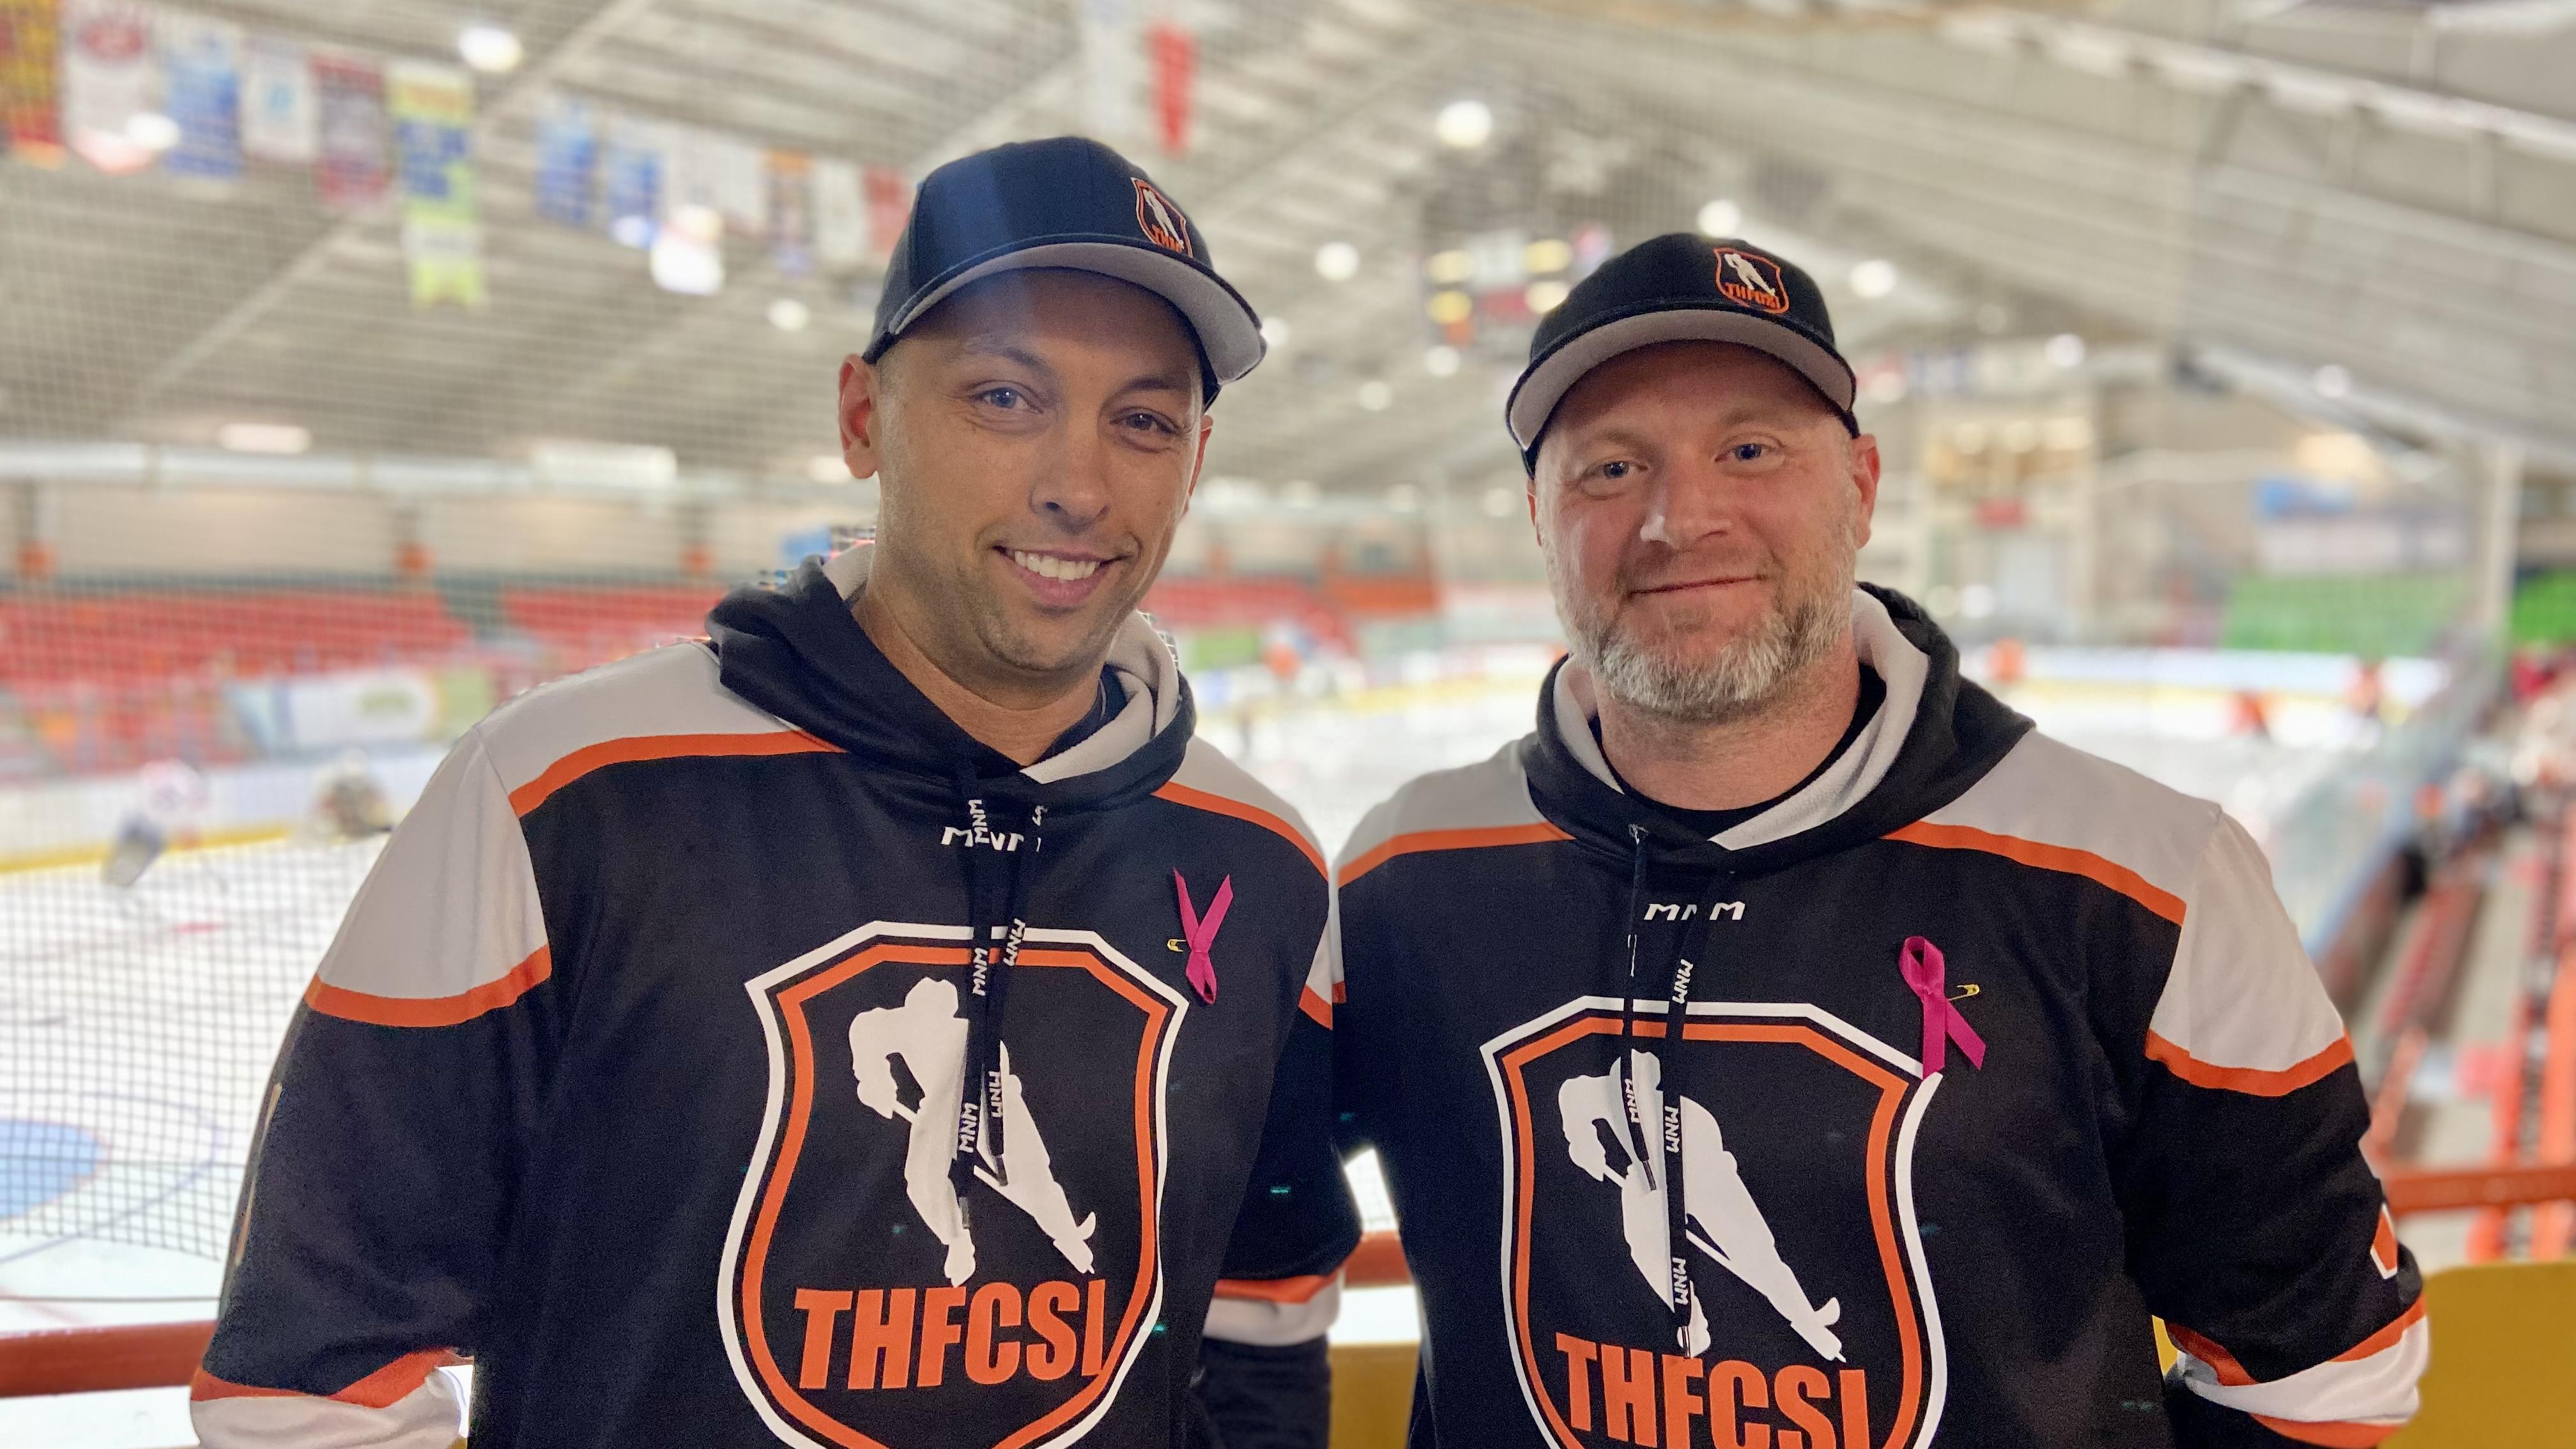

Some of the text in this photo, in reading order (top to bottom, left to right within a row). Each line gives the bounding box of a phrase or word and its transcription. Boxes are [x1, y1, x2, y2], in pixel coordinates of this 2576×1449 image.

[969, 799, 990, 844] MNM
[1002, 918, 1025, 967] MNM
[972, 947, 988, 996] MNM
[1672, 959, 1693, 1004] MNM
[988, 1071, 1003, 1117] MNM
[1625, 1078, 1640, 1123] MNM
[959, 1102, 978, 1153] MNM
[1664, 1105, 1680, 1153] MNM
[1672, 1257, 1688, 1305] MNM
[794, 1279, 1106, 1390] THFCSI
[1555, 1332, 1870, 1449] THFCSI
